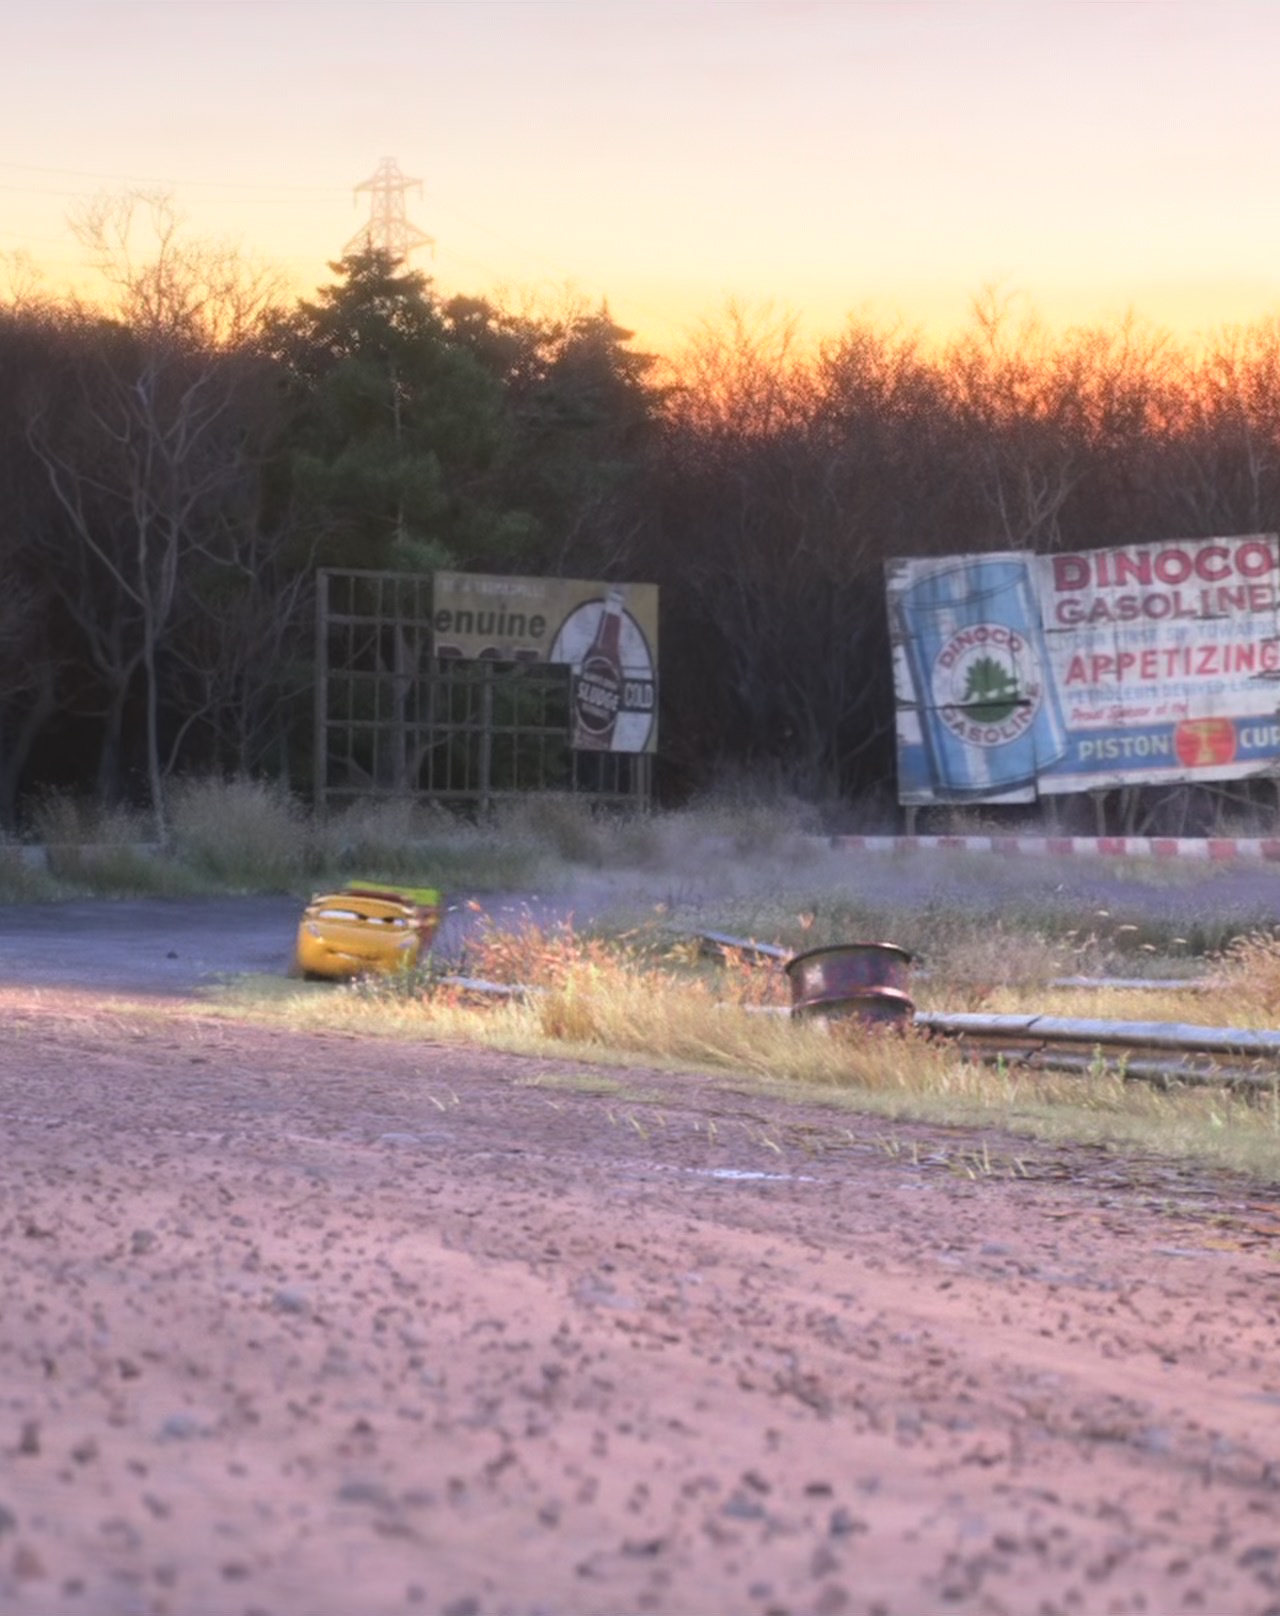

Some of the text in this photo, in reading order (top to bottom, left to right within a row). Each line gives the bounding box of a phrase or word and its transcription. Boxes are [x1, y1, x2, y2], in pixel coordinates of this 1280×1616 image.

[1053, 543, 1274, 591] DINOCO
[1055, 584, 1275, 625] GASOLINE
[940, 626, 1023, 669] DINOCO
[1065, 640, 1280, 686] APPETIZING
[624, 682, 653, 709] COLD
[941, 683, 1039, 743] GASOLINE
[1080, 739, 1170, 762] PISTON
